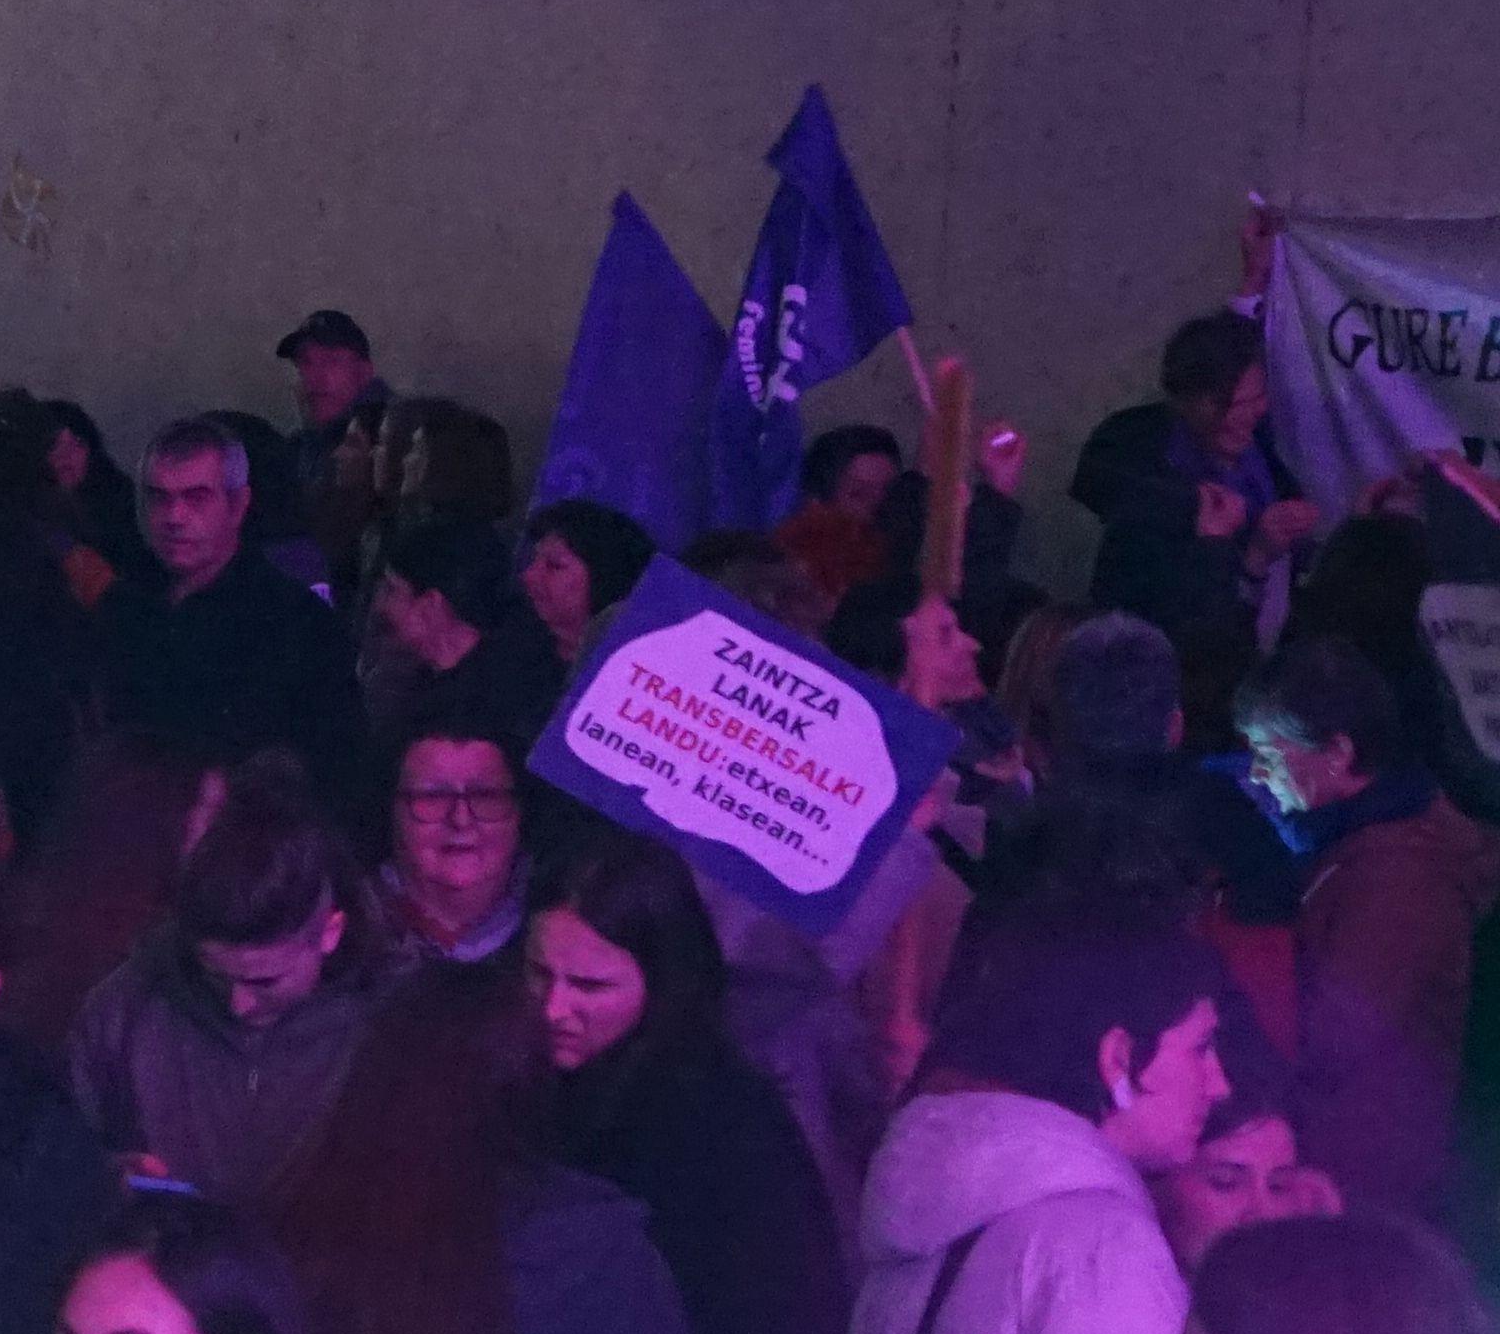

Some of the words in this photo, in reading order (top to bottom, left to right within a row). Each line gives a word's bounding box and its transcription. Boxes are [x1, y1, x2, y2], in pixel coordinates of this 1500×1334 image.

[1328, 299, 1468, 376] GURE
[711, 673, 815, 741] LANAK
[713, 638, 841, 720] ZAINTZA
[577, 713, 681, 786] lanean,
[629, 662, 864, 806] TRANSBERSALKI
